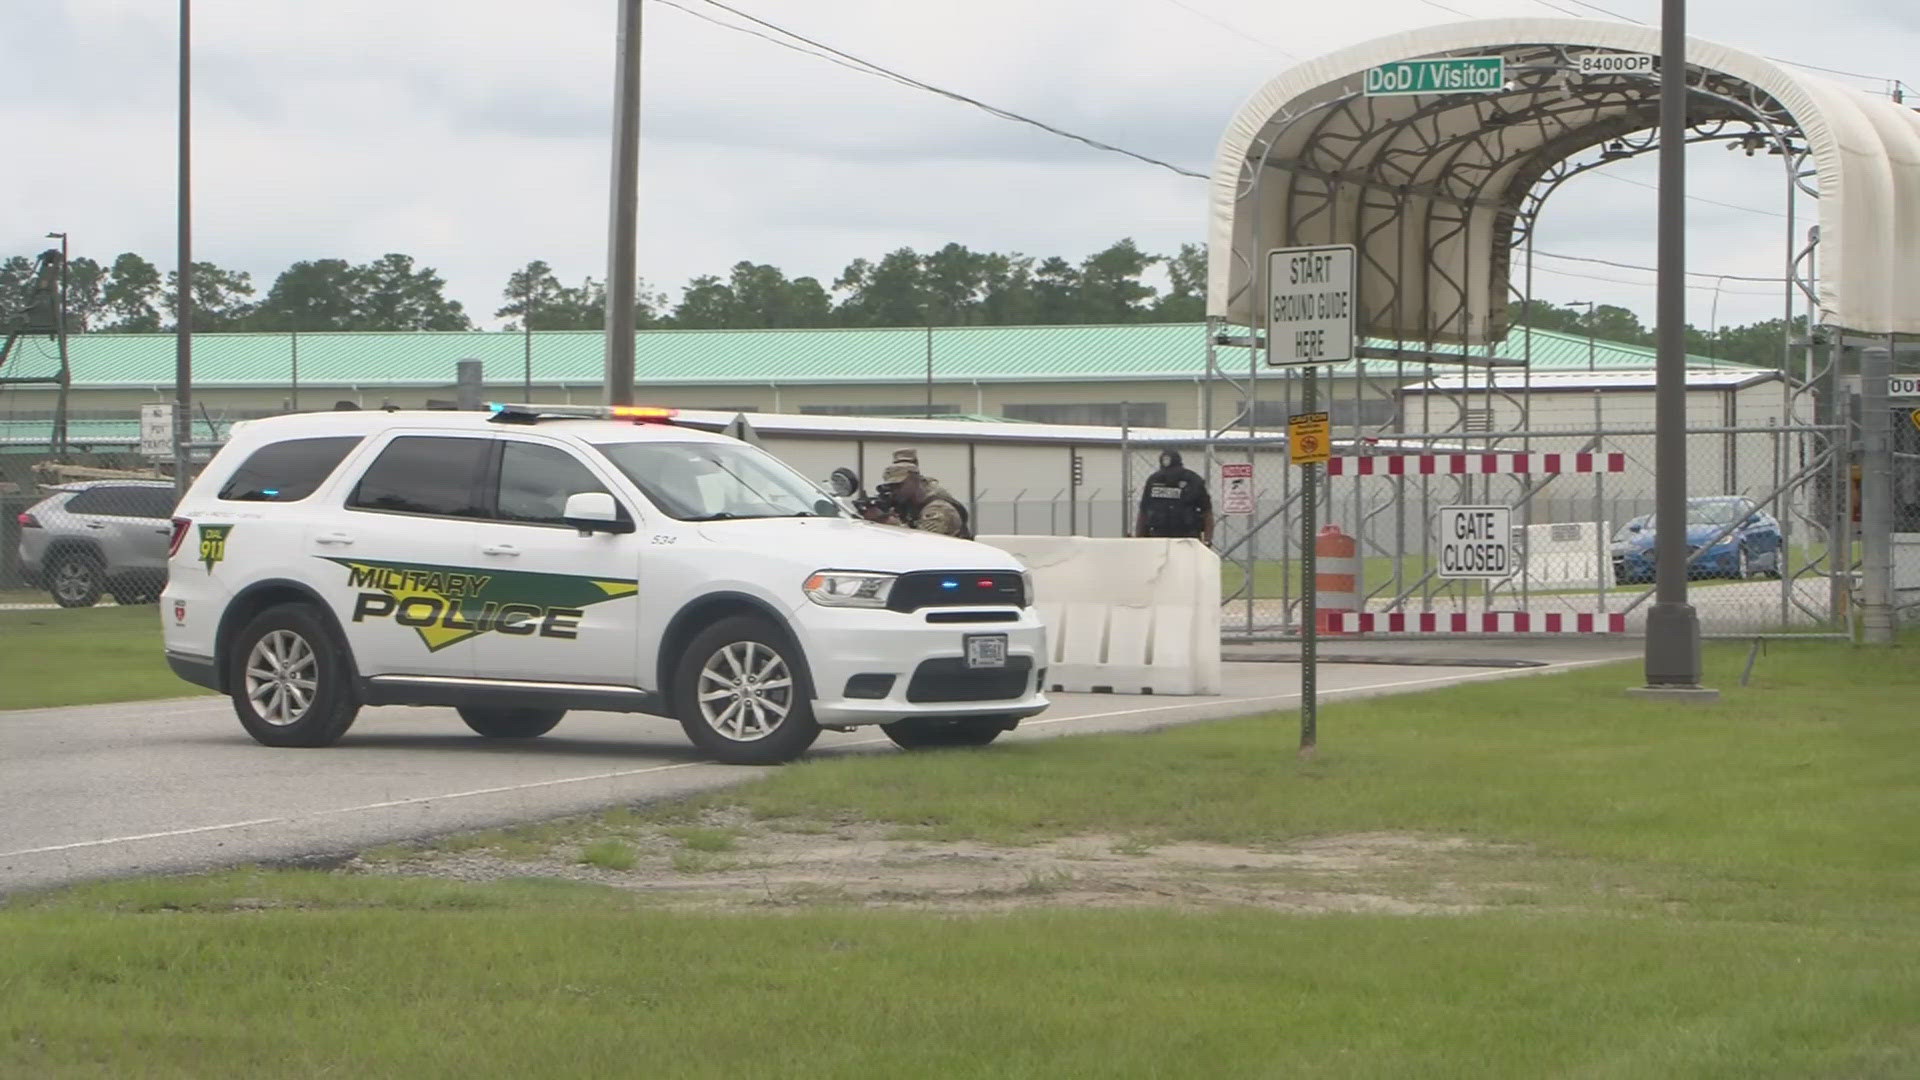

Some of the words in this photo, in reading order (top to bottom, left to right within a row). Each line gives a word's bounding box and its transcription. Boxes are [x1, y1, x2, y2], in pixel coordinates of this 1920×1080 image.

[1369, 65, 1413, 91] DoD
[1417, 63, 1426, 89] /
[1430, 62, 1499, 88] Visitor
[1290, 255, 1332, 284] START
[1273, 293, 1315, 322] GROUND
[1318, 291, 1348, 320] GUIDE
[1296, 329, 1324, 358] HERE
[1455, 512, 1495, 540] GATE
[200, 540, 224, 559] 911
[1443, 543, 1506, 572] CLOSED
[347, 566, 492, 598] MILITARY
[351, 591, 585, 640] POLICE
